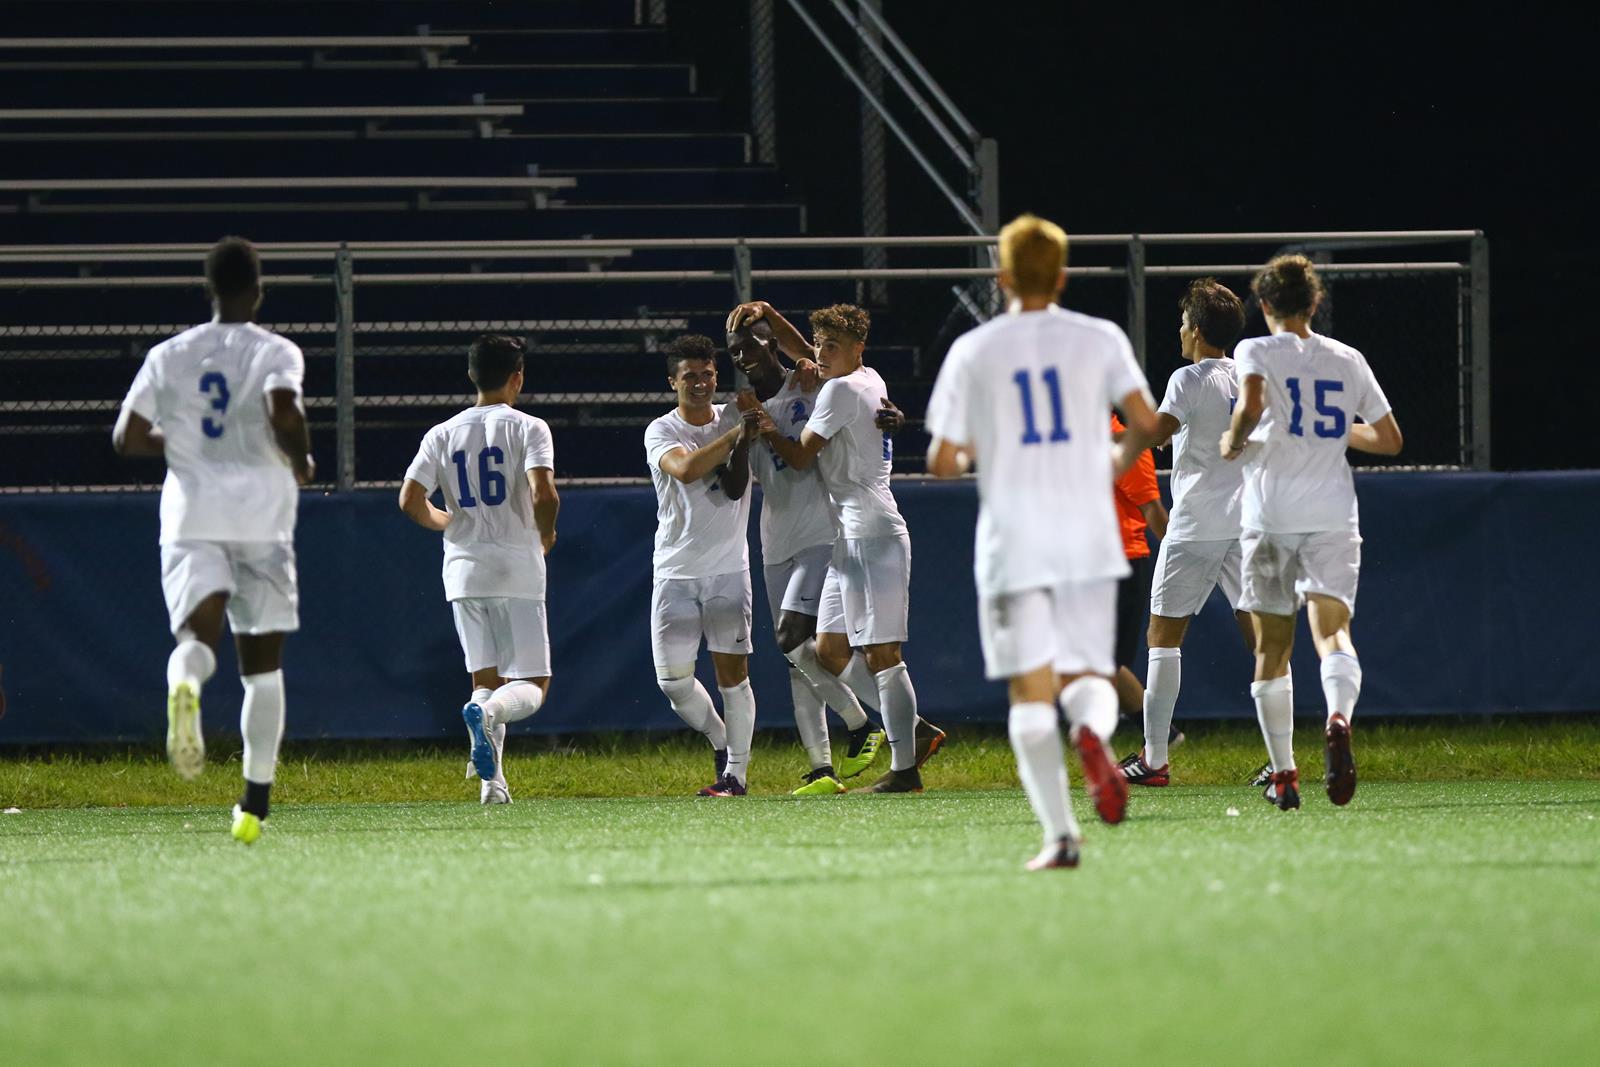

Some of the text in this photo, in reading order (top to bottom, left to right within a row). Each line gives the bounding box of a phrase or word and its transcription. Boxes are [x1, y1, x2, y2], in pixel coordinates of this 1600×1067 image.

[199, 371, 230, 439] 3
[1012, 366, 1072, 445] 11
[1285, 377, 1346, 439] 15
[452, 446, 506, 507] 16
